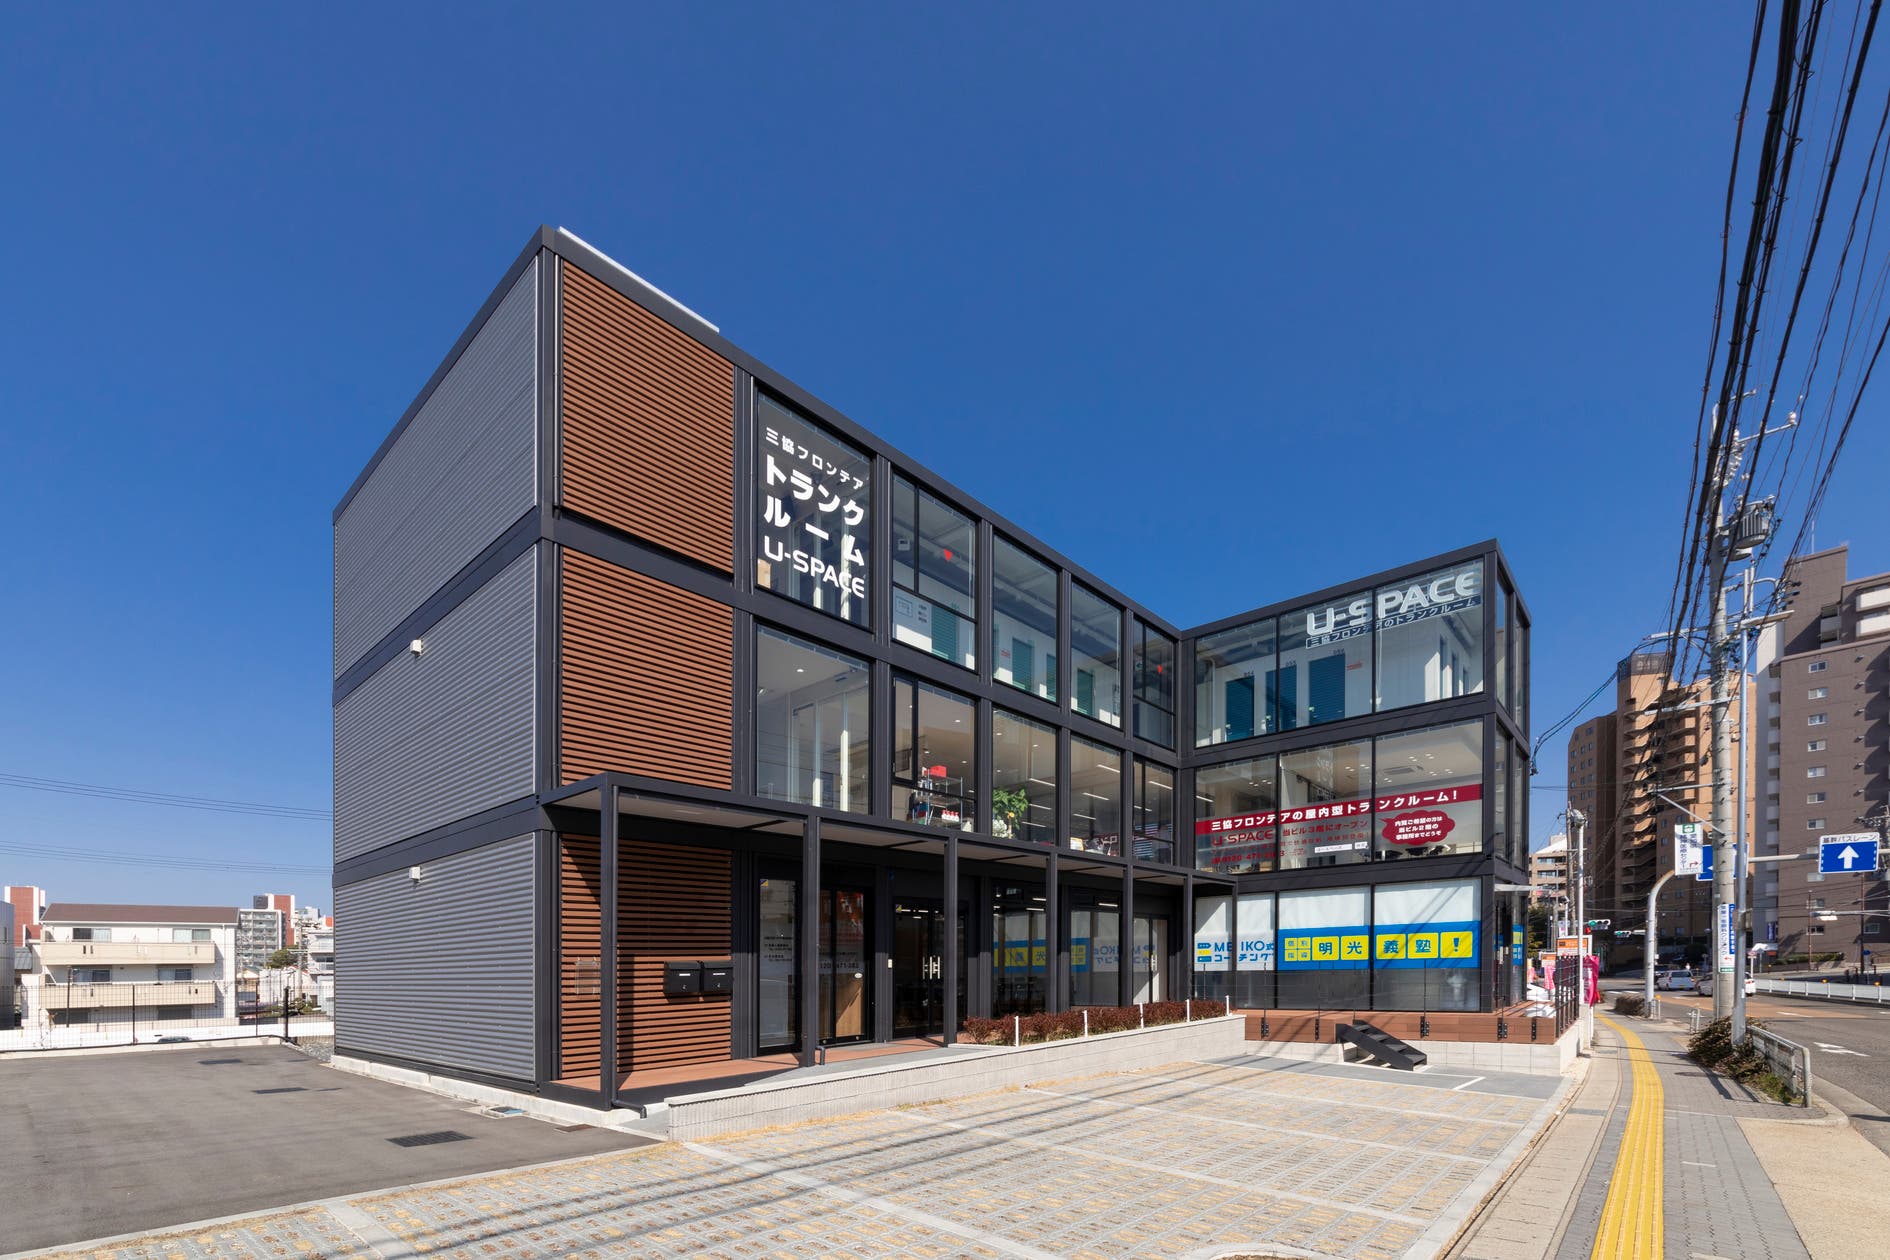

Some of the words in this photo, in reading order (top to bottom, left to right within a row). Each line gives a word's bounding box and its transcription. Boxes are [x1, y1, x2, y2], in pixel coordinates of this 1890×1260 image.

[765, 426, 864, 490] 三協フロンテア
[766, 454, 865, 526] トランク
[764, 496, 865, 567] ルーム
[764, 535, 865, 599] U-SPACE
[1306, 571, 1475, 637] U-SPACE
[1211, 829, 1274, 847] U-SPACE
